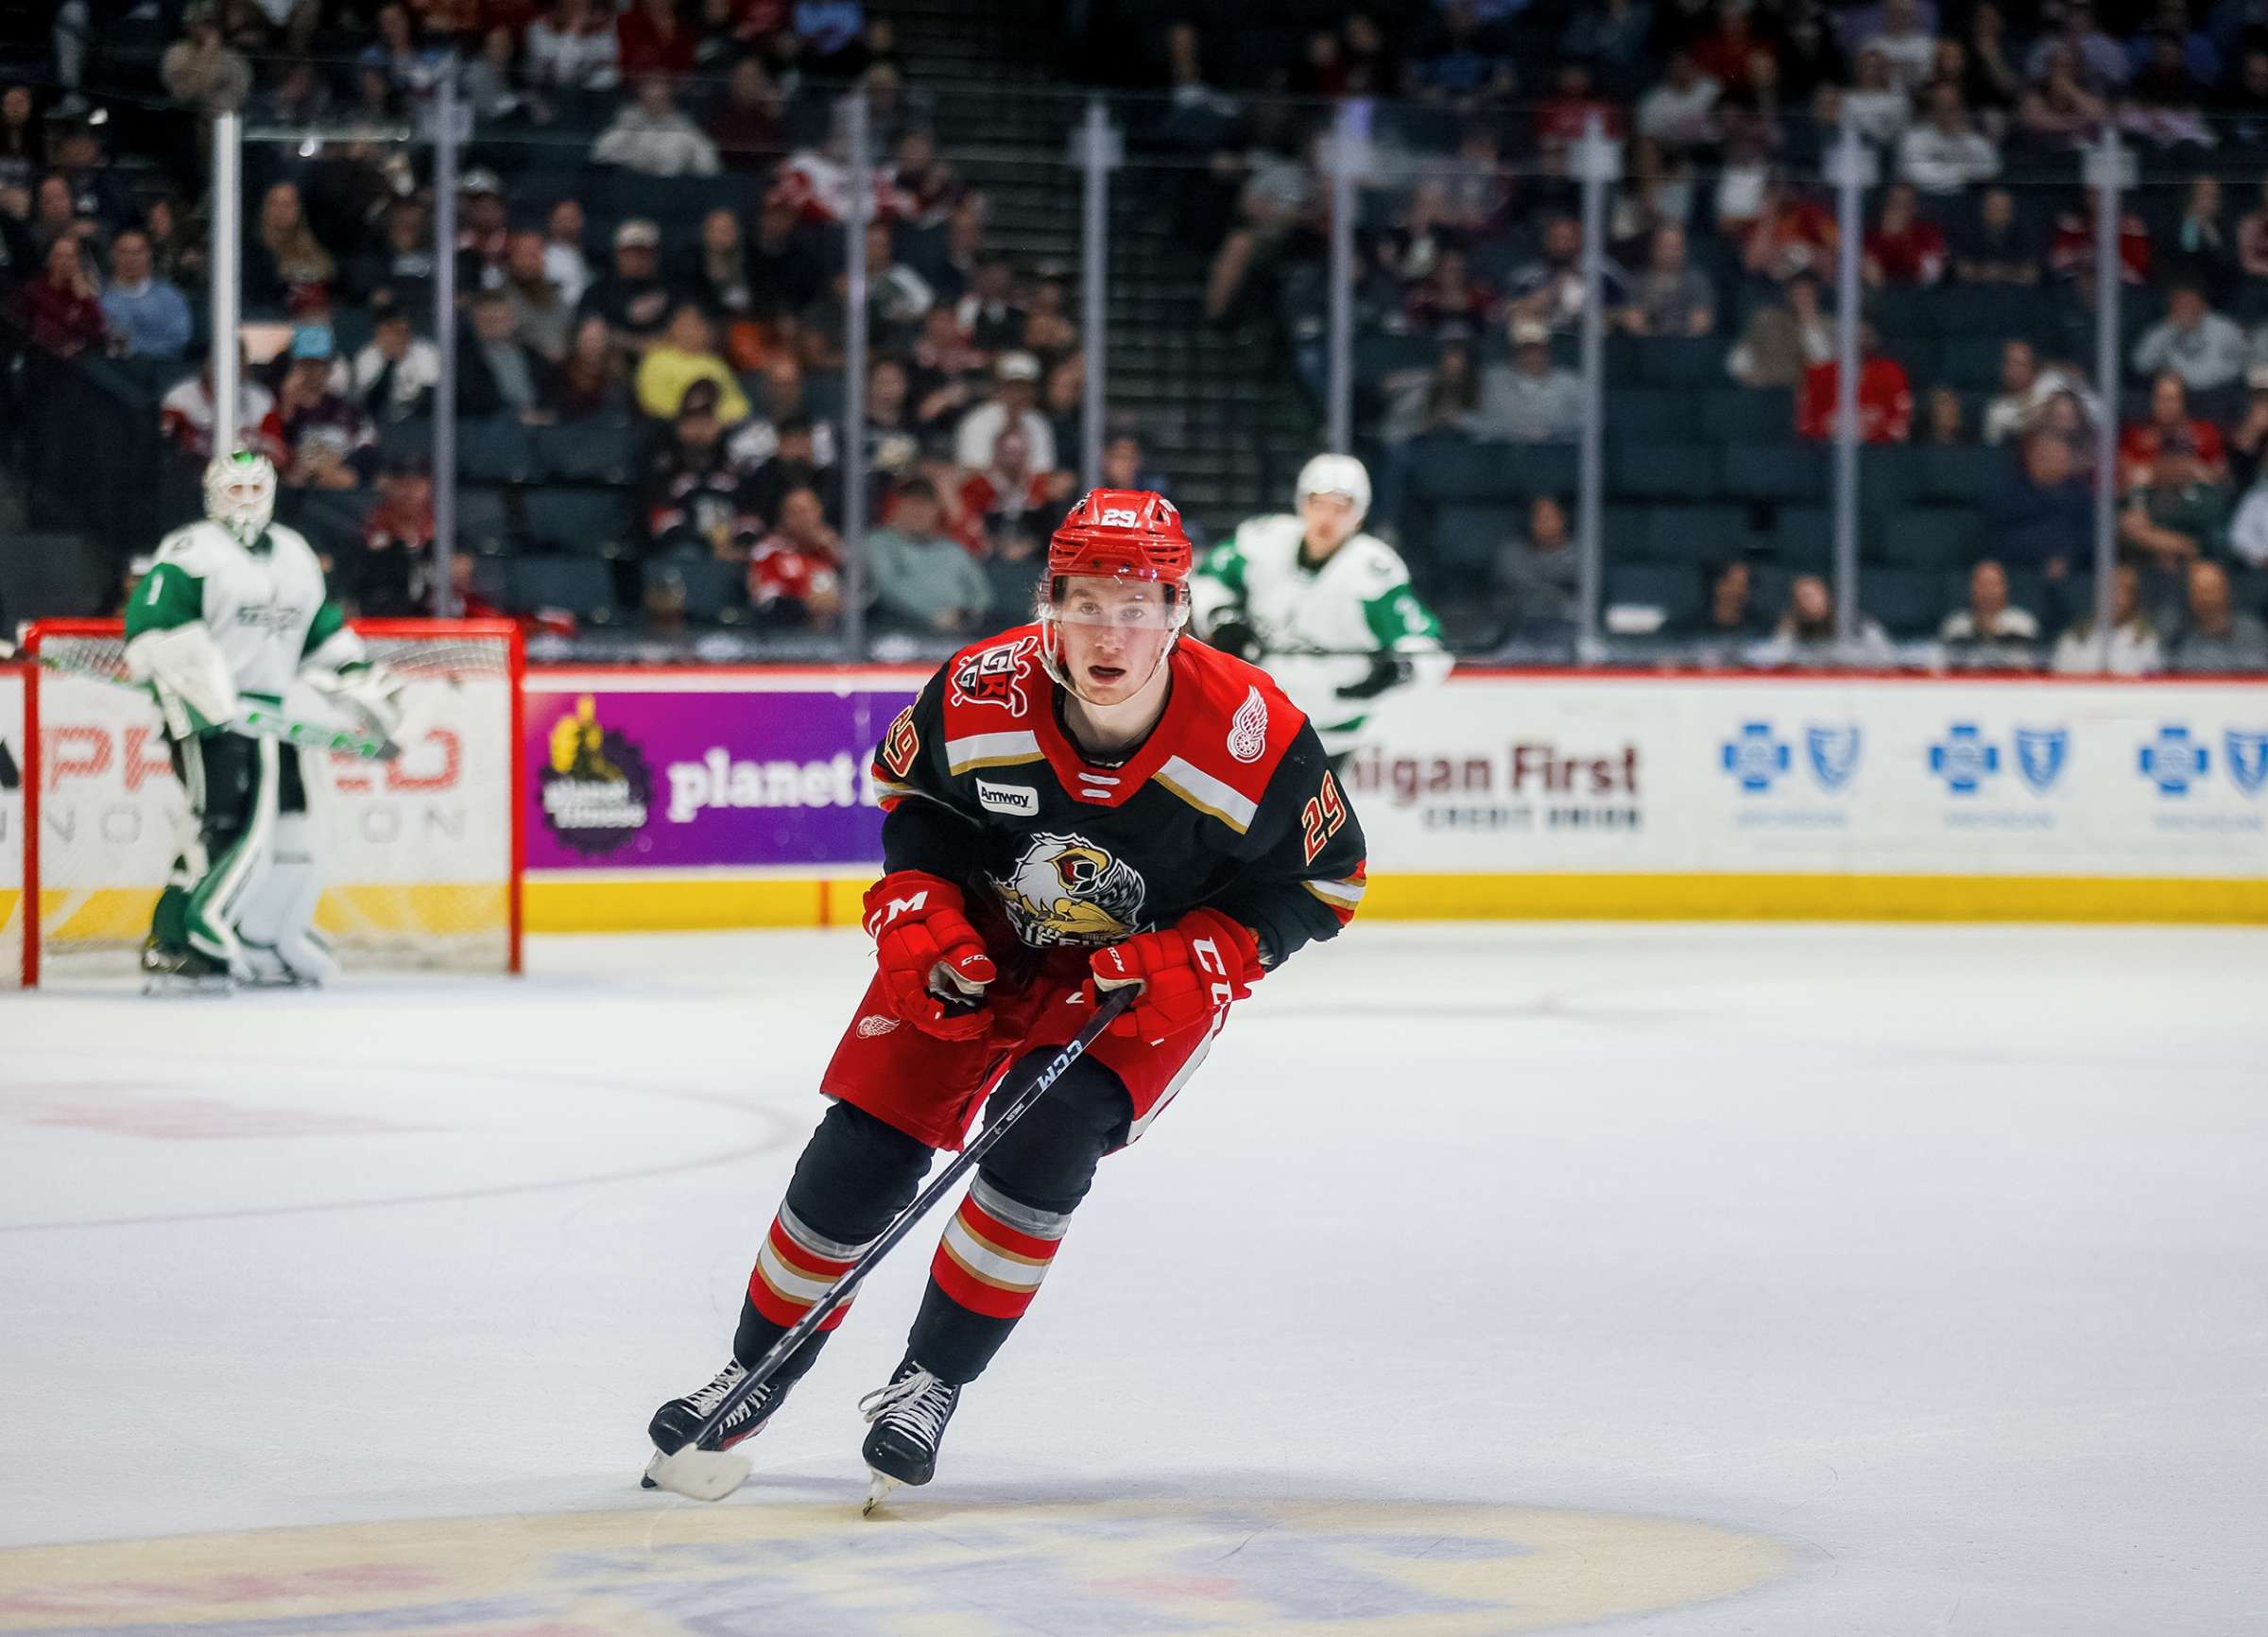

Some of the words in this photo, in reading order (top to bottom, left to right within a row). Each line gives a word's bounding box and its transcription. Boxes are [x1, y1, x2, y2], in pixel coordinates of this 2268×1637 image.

[1101, 508, 1137, 528] 29
[146, 574, 164, 606] 1
[666, 747, 856, 823] planet
[1510, 743, 1641, 794] First
[981, 786, 1030, 808] Amway
[1301, 769, 1347, 867] 29
[868, 890, 929, 949] CM
[1193, 936, 1232, 1006] CC
[1037, 1040, 1084, 1092] CCM
